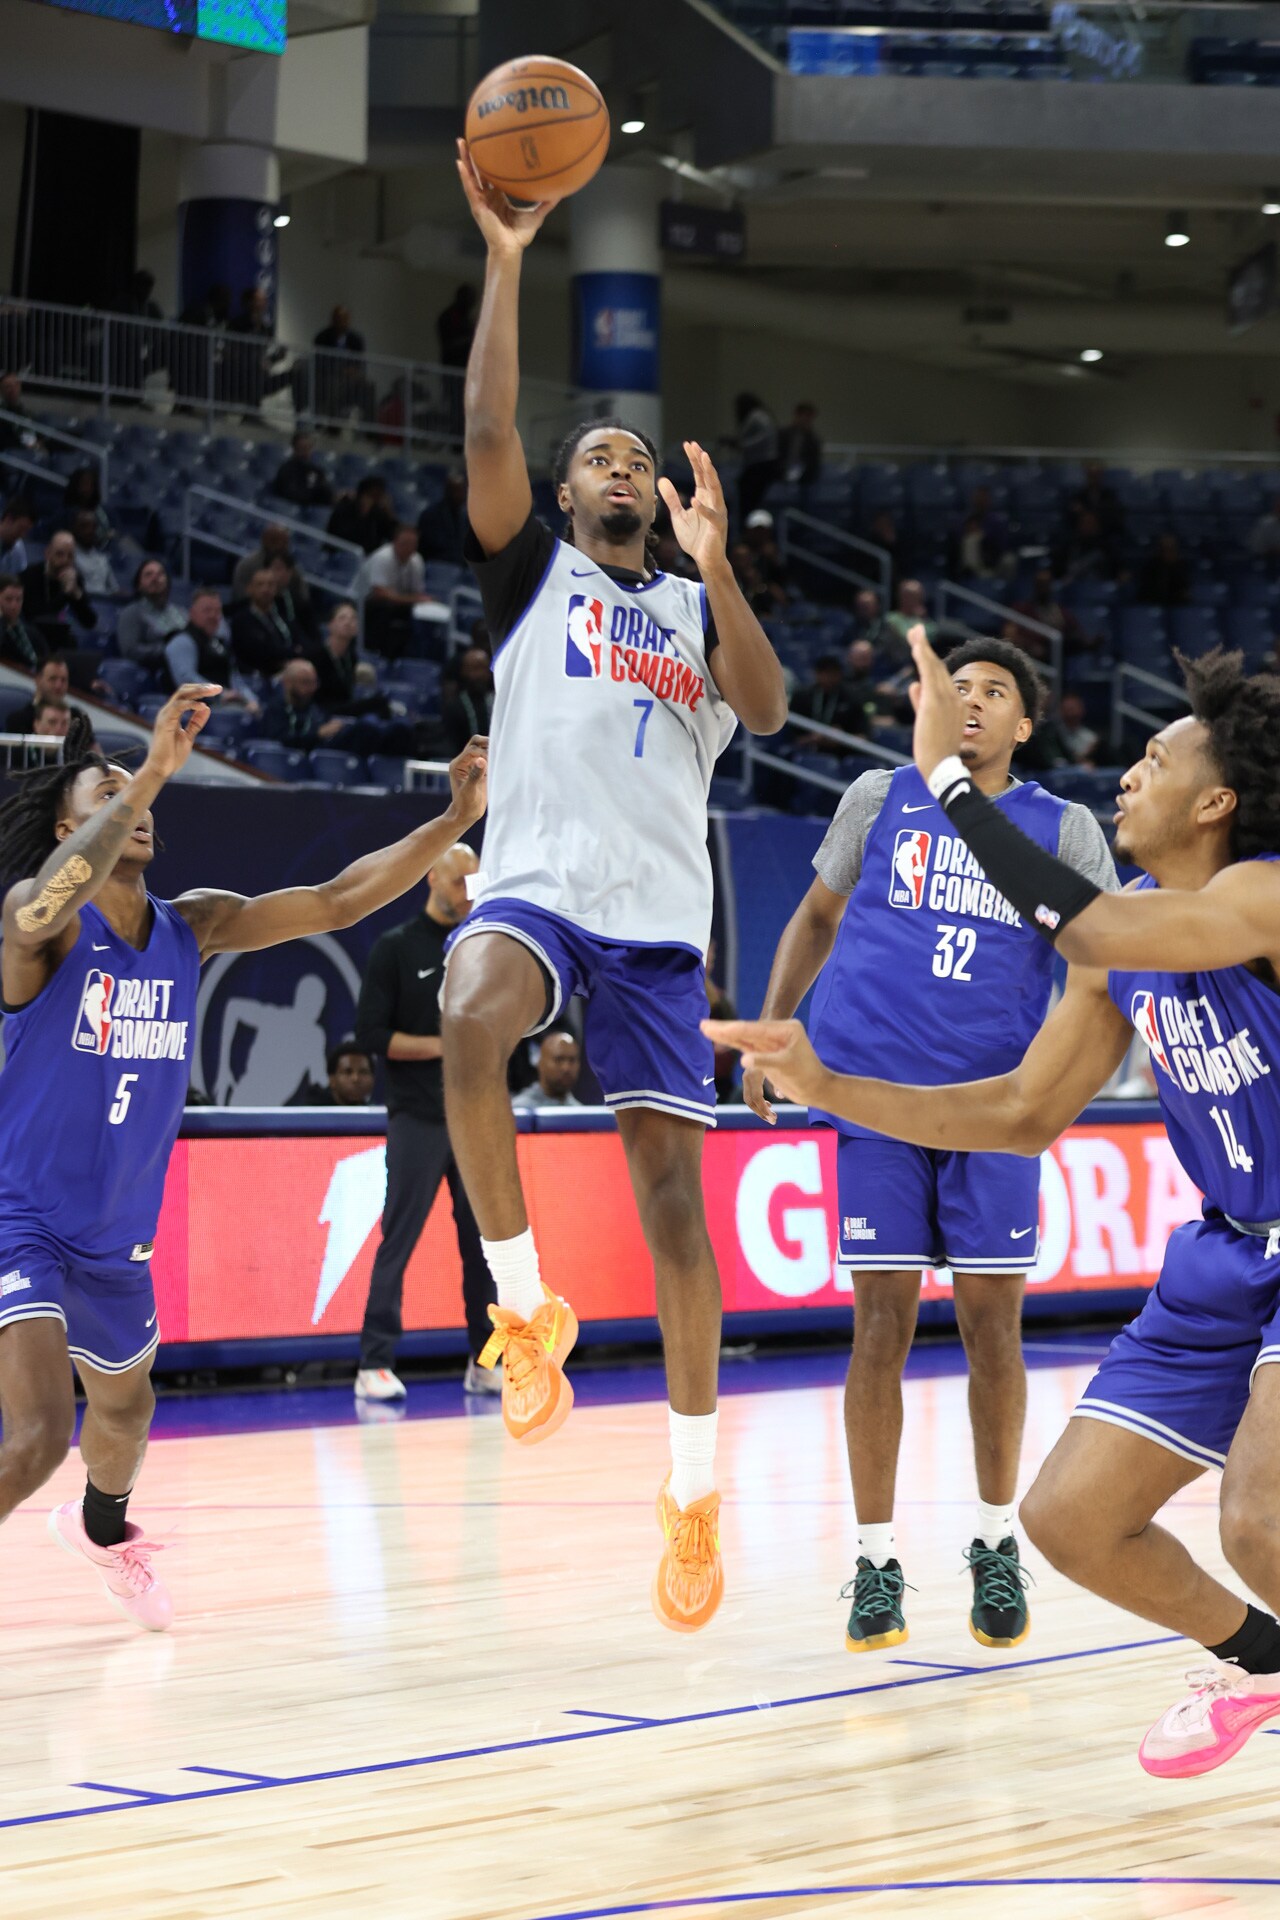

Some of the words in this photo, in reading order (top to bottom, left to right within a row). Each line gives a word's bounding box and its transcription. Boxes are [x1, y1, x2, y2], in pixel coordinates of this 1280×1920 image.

[477, 85, 571, 119] Wilson
[611, 644, 705, 713] COMBINE
[633, 699, 655, 758] 7
[933, 835, 986, 880] DRA
[893, 889, 910, 903] NBA
[931, 924, 977, 981] 32
[112, 979, 175, 1019] DRAFT
[77, 1031, 96, 1047] NBA
[111, 1019, 189, 1060] COMBINE
[108, 1073, 139, 1125] 5
[1209, 1105, 1254, 1172] 14
